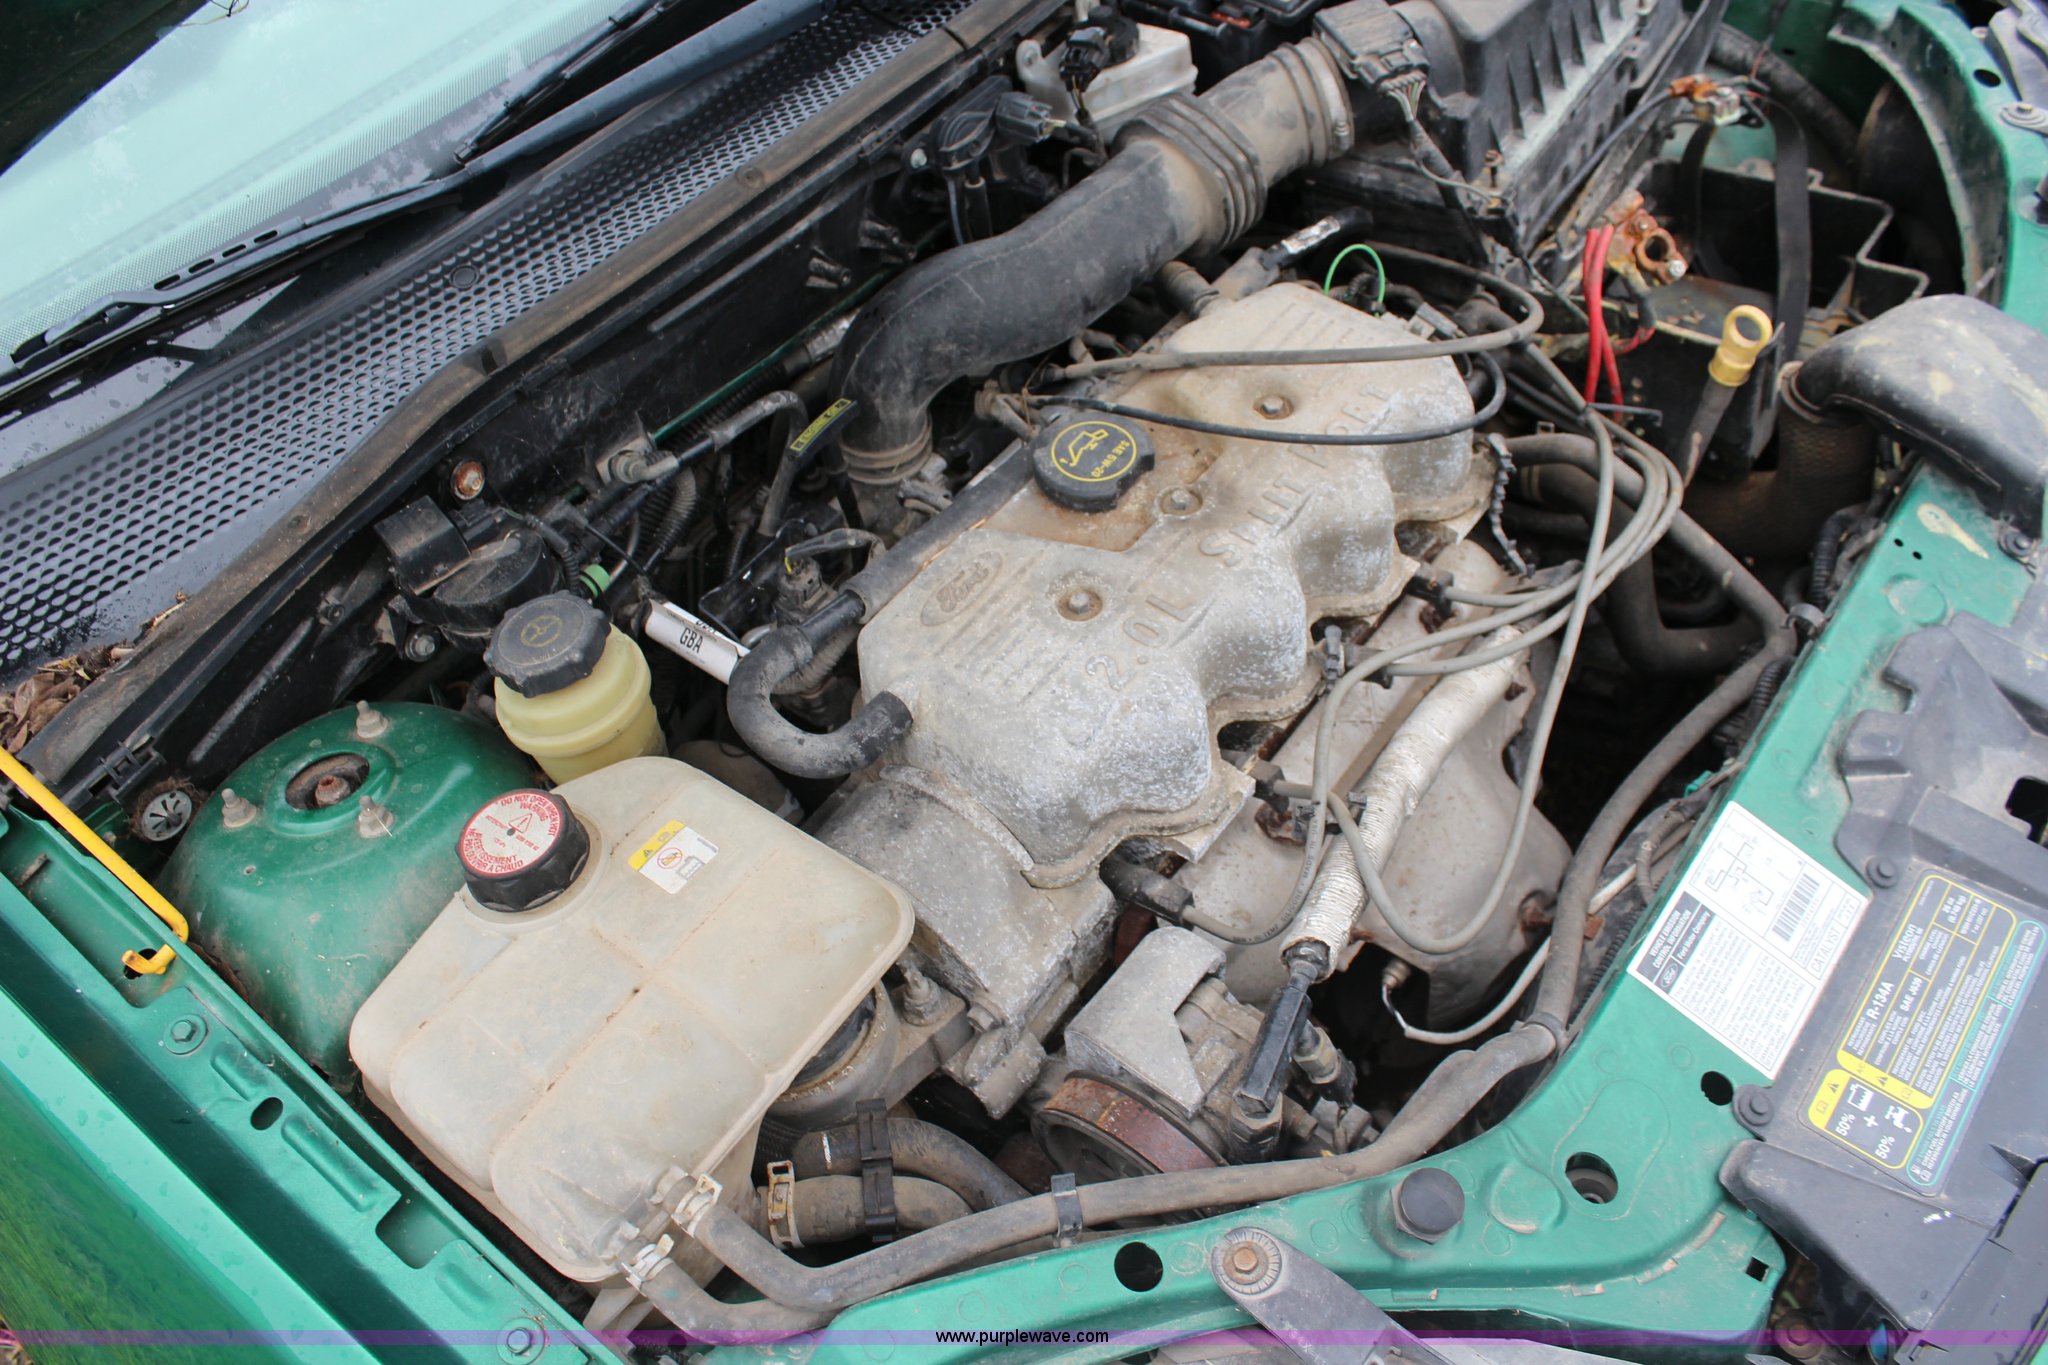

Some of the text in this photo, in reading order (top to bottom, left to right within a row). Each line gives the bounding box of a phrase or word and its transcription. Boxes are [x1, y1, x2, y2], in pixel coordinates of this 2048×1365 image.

[1112, 440, 1130, 455] SAE
[1085, 595, 1196, 691] 2.0L
[1200, 474, 1302, 567] SPLIT
[680, 627, 703, 653] GBA
[500, 797, 513, 806] DO
[514, 795, 530, 803] NOT
[520, 802, 549, 822] WARNING
[495, 859, 524, 873] CHAUD
[1648, 909, 1681, 957] VEHICLE EMISSION
[1652, 908, 1692, 969] CONTROL INFORMATION
[1677, 909, 1710, 960] Ford Motor Company
[1891, 921, 1917, 960] Visteon
[1809, 925, 1841, 973] CATALYST
[1662, 966, 1676, 984] Ford
[1865, 979, 1894, 1020] R-134A
[1899, 976, 1923, 1012] SAE J639
[1835, 1113, 1856, 1136] 50%
[1875, 1136, 1896, 1159] 50%
